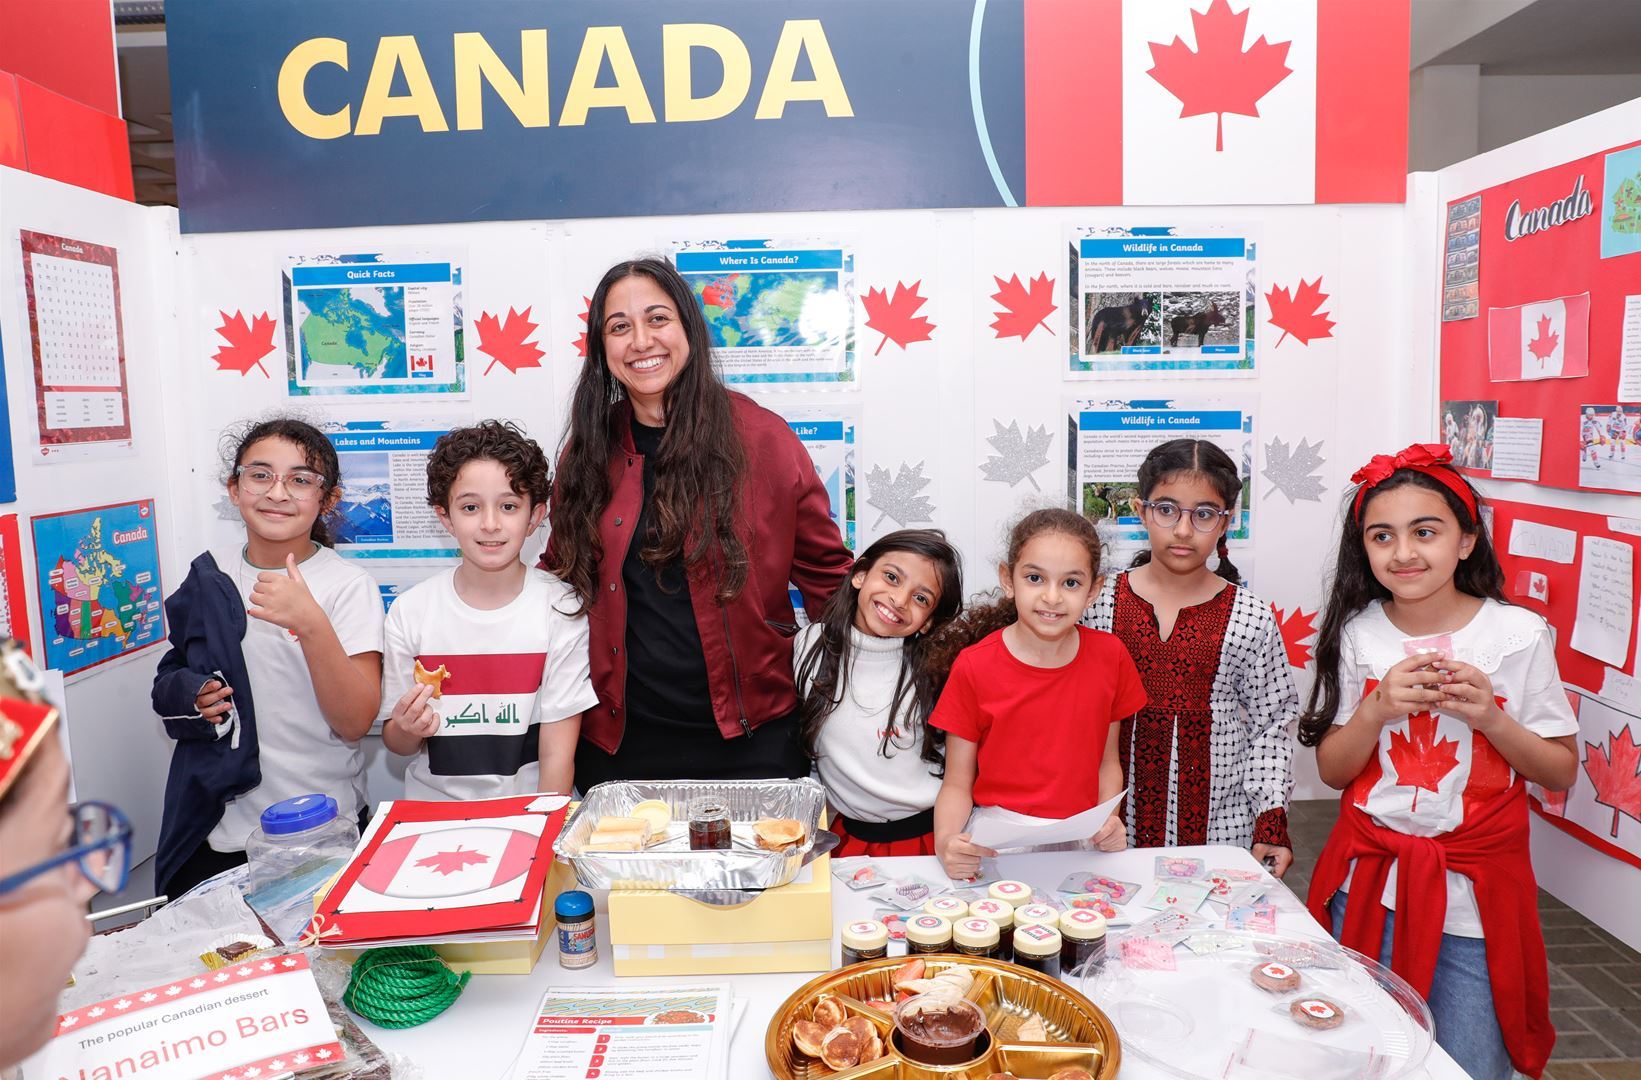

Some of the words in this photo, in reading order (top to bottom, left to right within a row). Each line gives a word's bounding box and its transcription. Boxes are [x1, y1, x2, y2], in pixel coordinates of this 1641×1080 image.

[277, 19, 855, 140] CANADA
[1505, 175, 1592, 241] Canada
[62, 243, 84, 254] Canada
[1122, 244, 1157, 254] Wildlife
[1170, 244, 1203, 252] Canada
[720, 257, 748, 265] Where
[761, 256, 799, 264] Canada?
[347, 270, 370, 279] Quick
[373, 270, 395, 279] Facts
[1121, 416, 1155, 426] Wildlife
[1168, 416, 1200, 424] Canada
[796, 427, 818, 435] Like?
[335, 437, 358, 446] Lakes
[360, 437, 375, 446] and
[377, 437, 421, 446] Mountains
[114, 527, 148, 545] Canada
[1511, 531, 1571, 560] CANADA
[444, 703, 490, 729] اكبر
[495, 702, 520, 724] الله
[78, 1036, 105, 1050] The
[107, 1018, 158, 1042] popular
[161, 1001, 222, 1024] Canadian
[224, 988, 269, 1006] dessert
[236, 1008, 310, 1039] Bars
